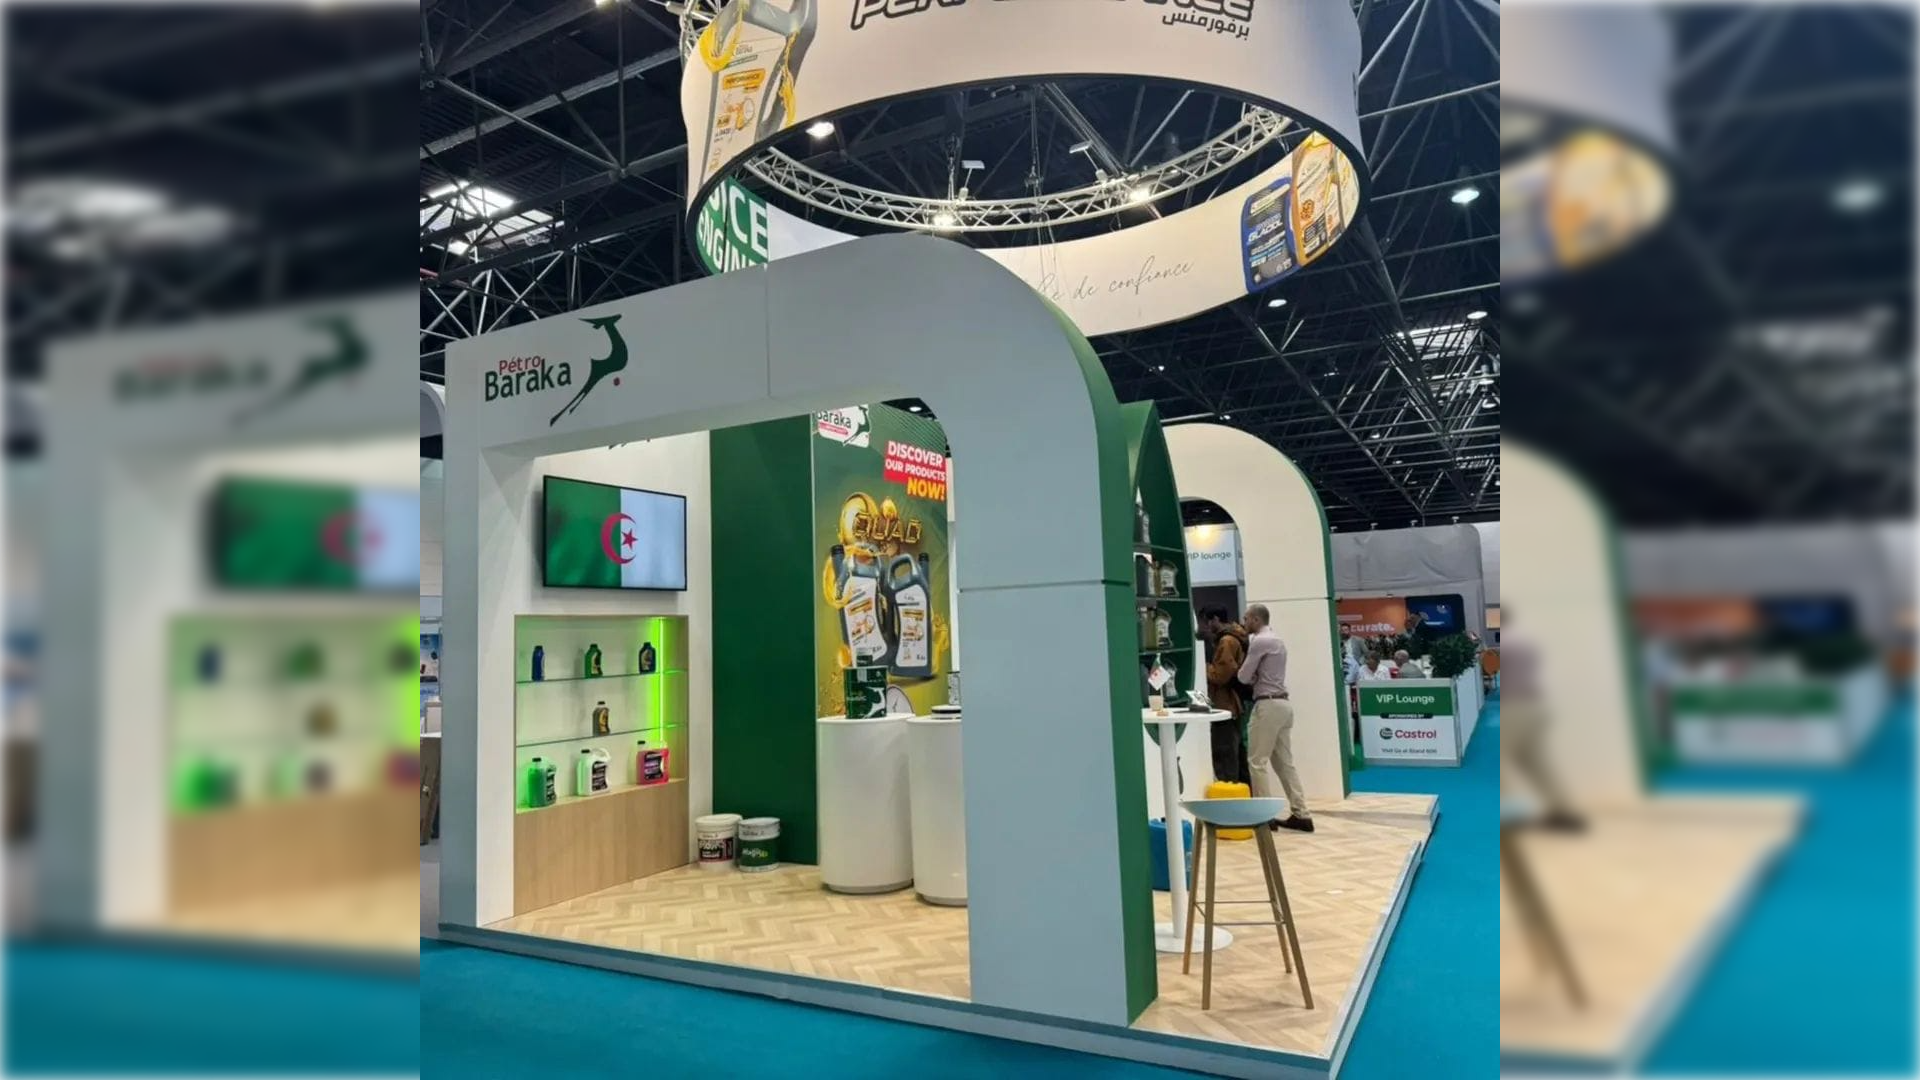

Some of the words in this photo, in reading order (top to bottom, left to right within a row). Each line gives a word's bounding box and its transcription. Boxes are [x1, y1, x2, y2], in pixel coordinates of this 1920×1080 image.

[1162, 10, 1250, 40] برفورمنس
[697, 208, 757, 273] ENGIN
[1073, 275, 1098, 300] de
[1108, 255, 1194, 295] confiance
[499, 355, 541, 375] Pétro
[485, 358, 572, 402] Baraka
[887, 440, 943, 467] DISCOVER
[885, 458, 904, 473] OUR
[905, 463, 946, 482] PRODUCTS
[907, 476, 945, 501] NOW!
[853, 512, 922, 544] QUAD
[1200, 551, 1232, 561] lounge
[1350, 622, 1396, 633] curate.
[1375, 694, 1394, 704] VIP
[1395, 694, 1435, 705] Lounge
[1394, 729, 1437, 739] Castrol
